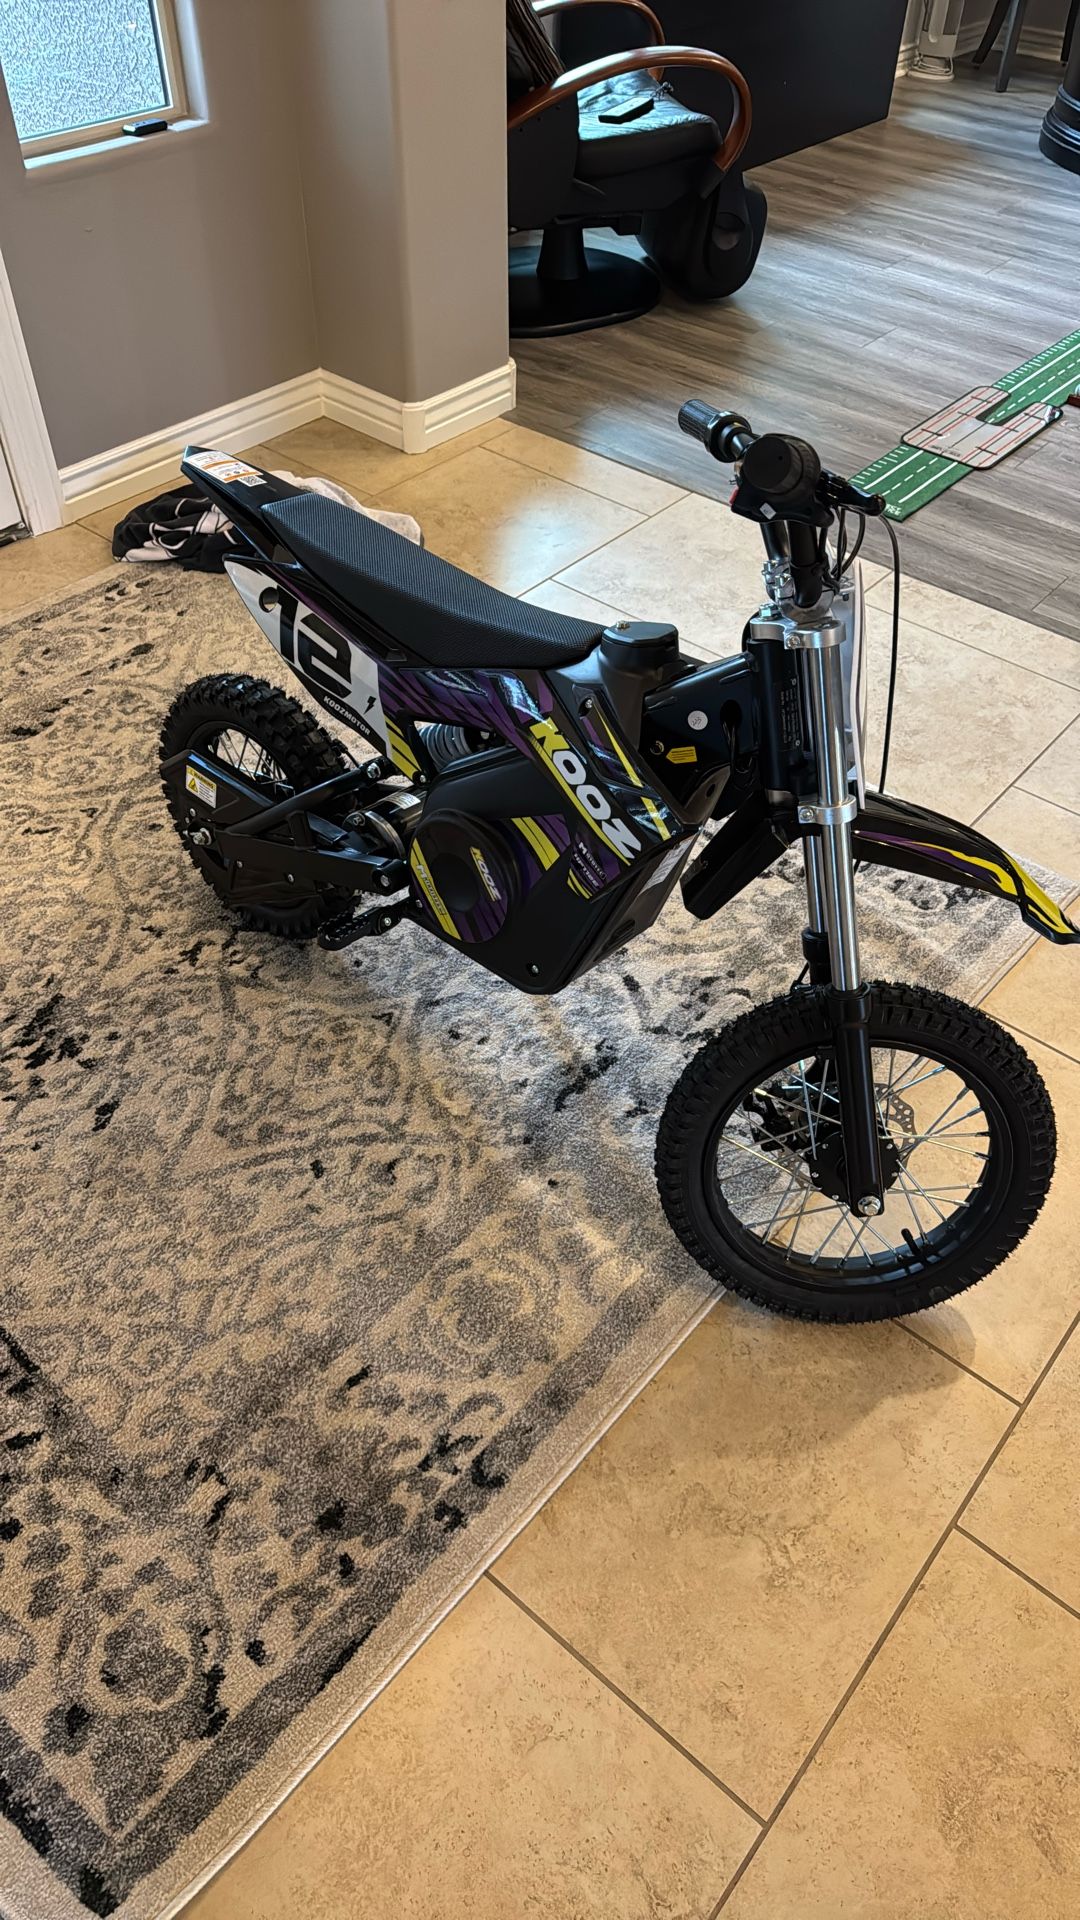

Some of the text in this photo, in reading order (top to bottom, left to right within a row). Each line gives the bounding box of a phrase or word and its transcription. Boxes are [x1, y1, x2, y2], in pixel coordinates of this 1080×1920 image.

[323, 695, 371, 736] KOOZMOTOR
[529, 716, 642, 859] KOOZ
[469, 847, 502, 900] KOOZ
